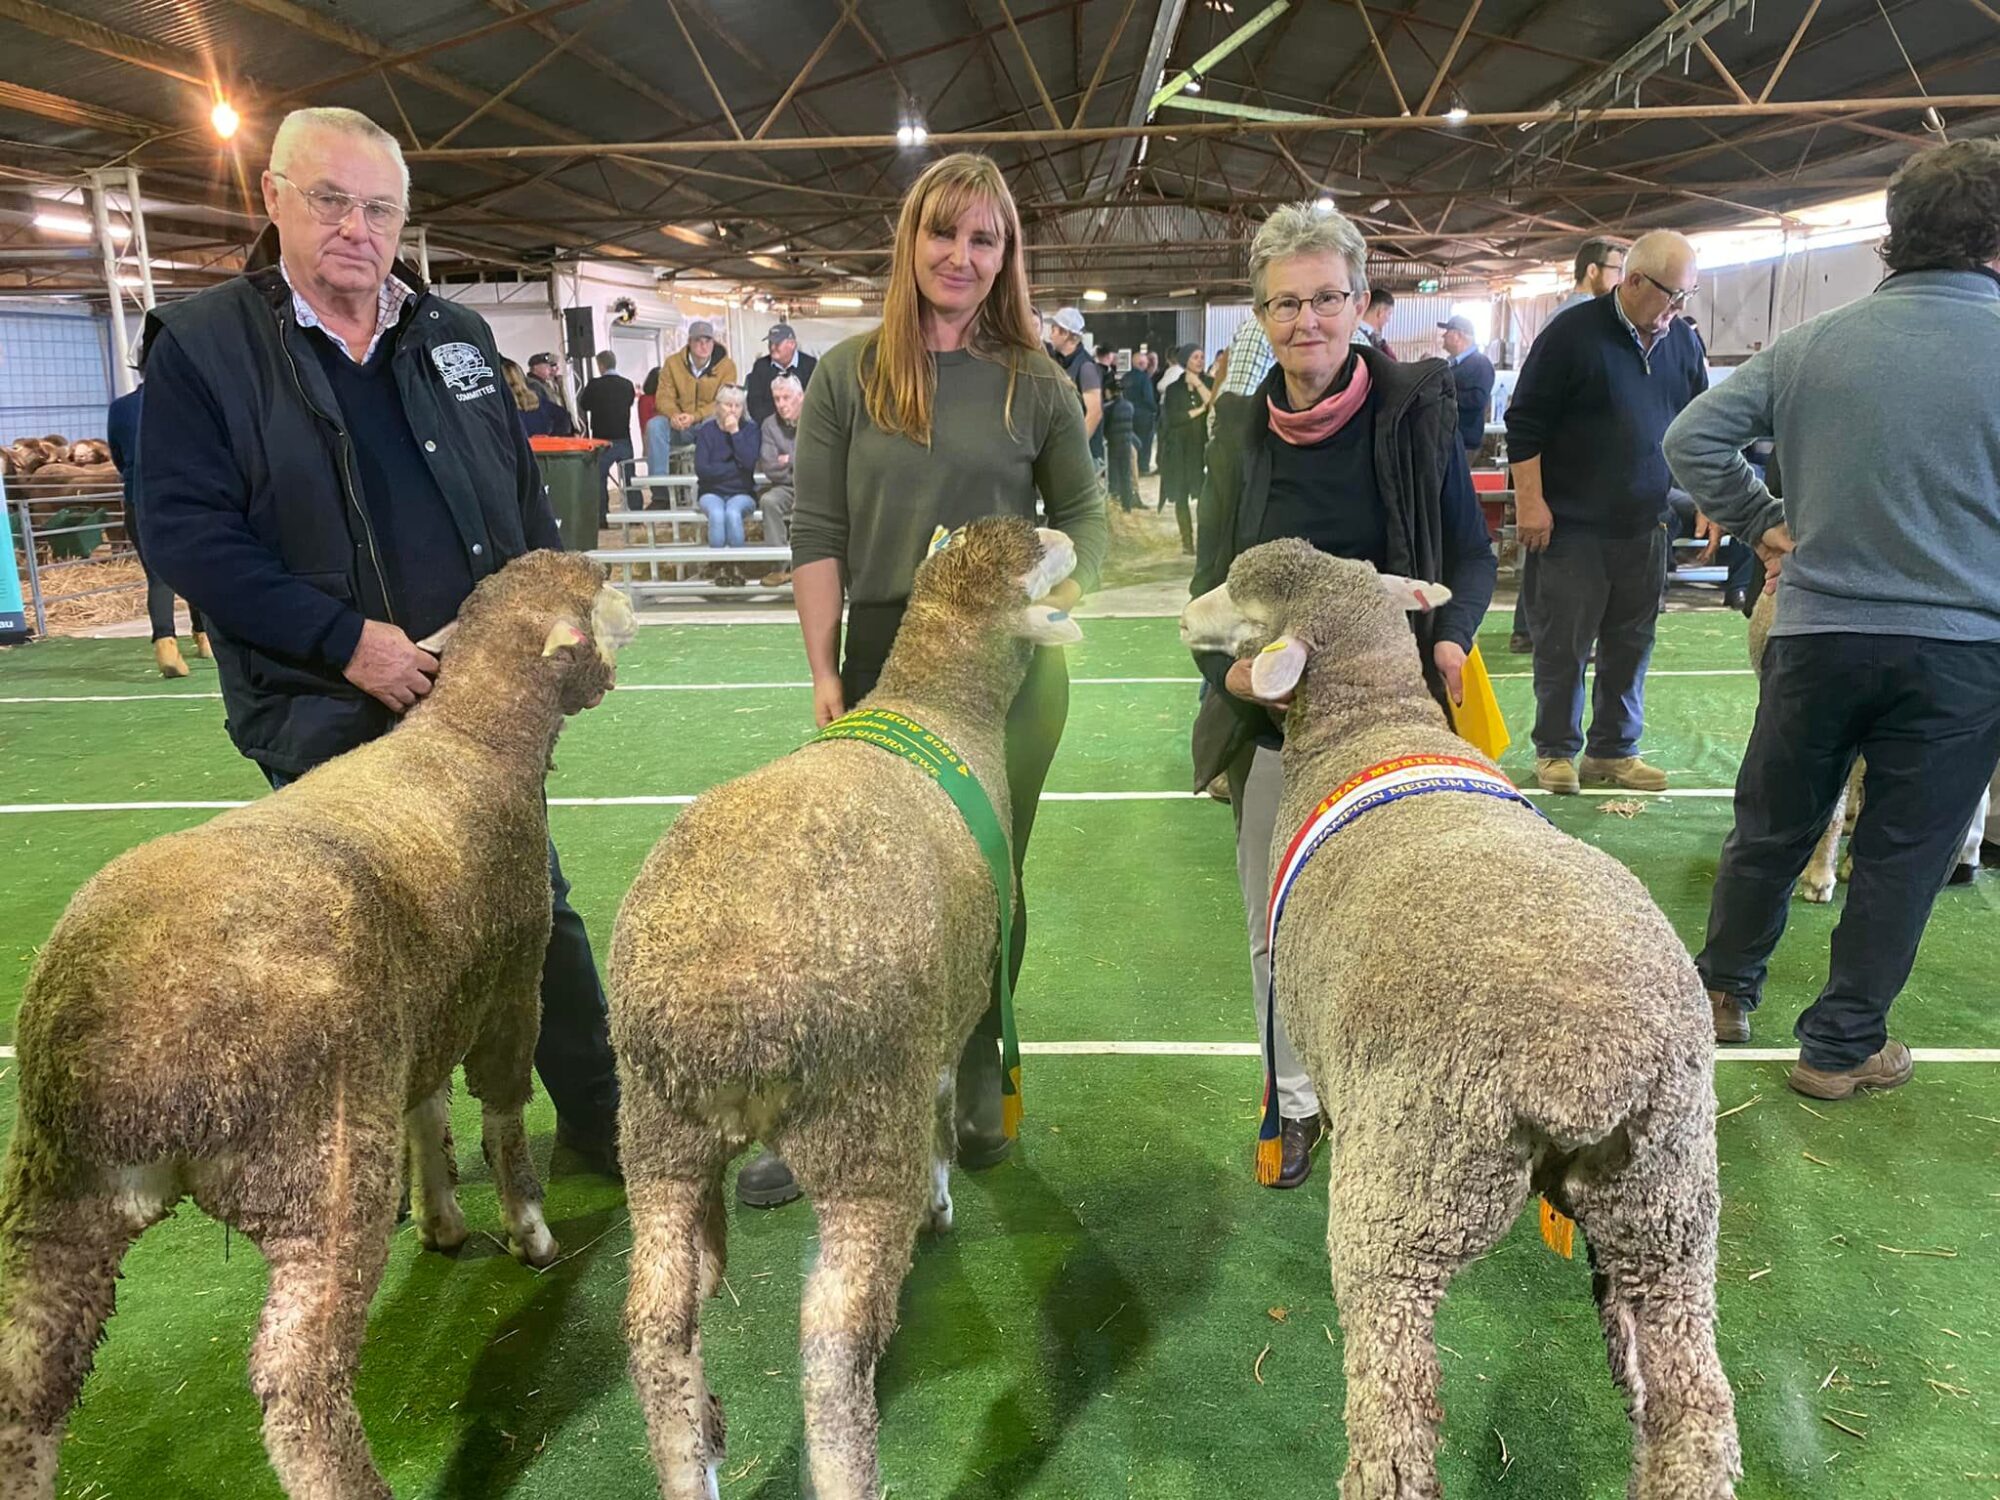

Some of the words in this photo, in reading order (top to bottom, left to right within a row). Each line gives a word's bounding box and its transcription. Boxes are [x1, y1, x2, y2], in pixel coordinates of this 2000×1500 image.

[455, 384, 496, 402] COMMITTEE
[874, 711, 923, 733] SHOW
[855, 730, 909, 753] SHORN
[908, 751, 942, 778] EWE
[1329, 775, 1363, 804] HAY
[1368, 756, 1452, 778] MERINO
[1305, 791, 1385, 857] CHAMPION
[1388, 778, 1467, 796] MEDIUM
[1469, 780, 1517, 795] WOO
